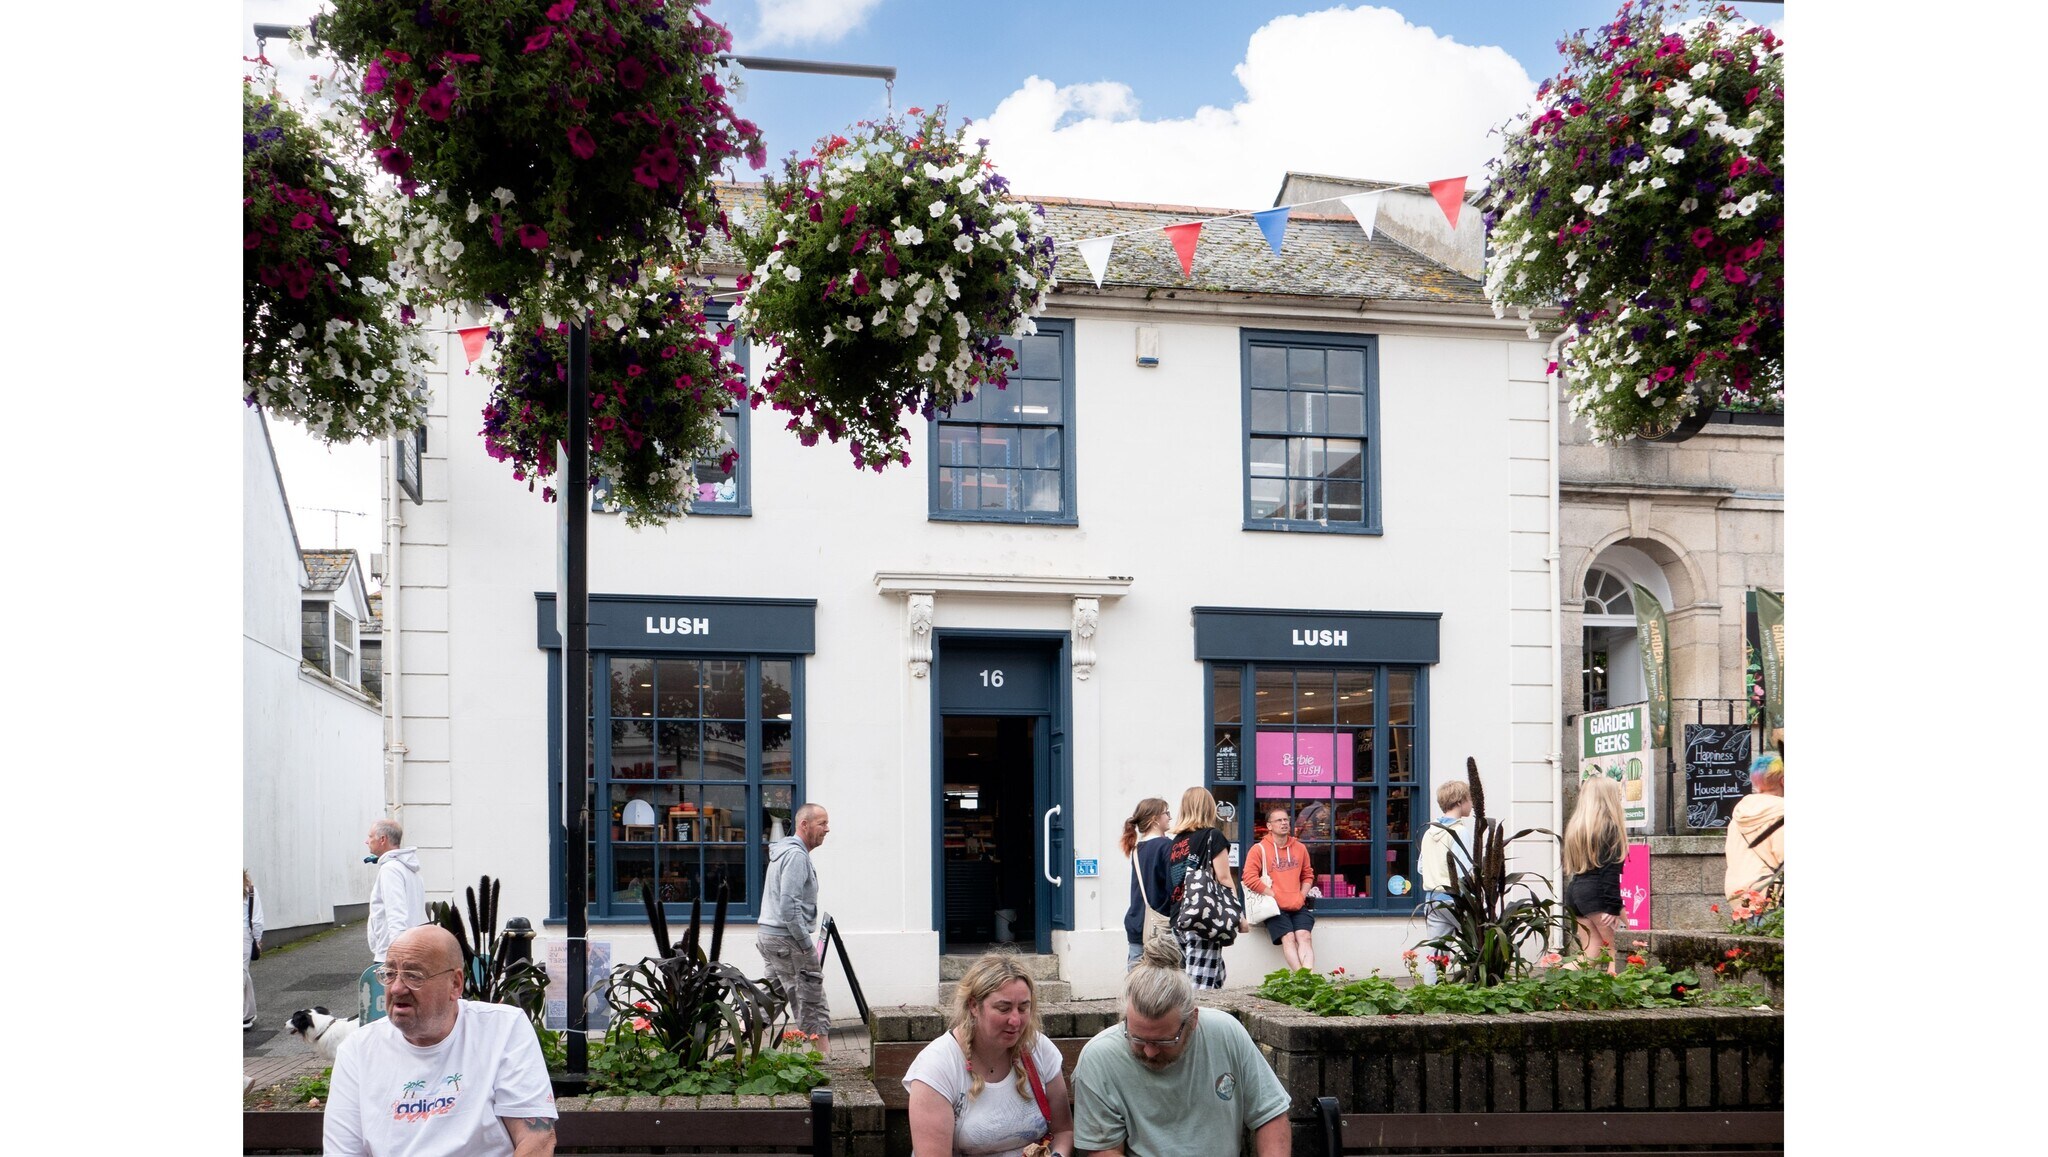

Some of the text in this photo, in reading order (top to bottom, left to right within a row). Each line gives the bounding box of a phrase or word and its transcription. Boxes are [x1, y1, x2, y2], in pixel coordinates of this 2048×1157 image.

[646, 616, 709, 635] LUSH
[1292, 629, 1348, 647] LUSH
[1649, 619, 1664, 663] GARDEN
[979, 669, 1004, 688] 16
[1590, 711, 1635, 735] GARDEN
[1594, 733, 1630, 754] GEEKS
[1695, 745, 1734, 767] Happiness
[1694, 782, 1740, 800] Houseplant
[1170, 846, 1190, 862] MORE
[397, 1097, 456, 1115] adidas
